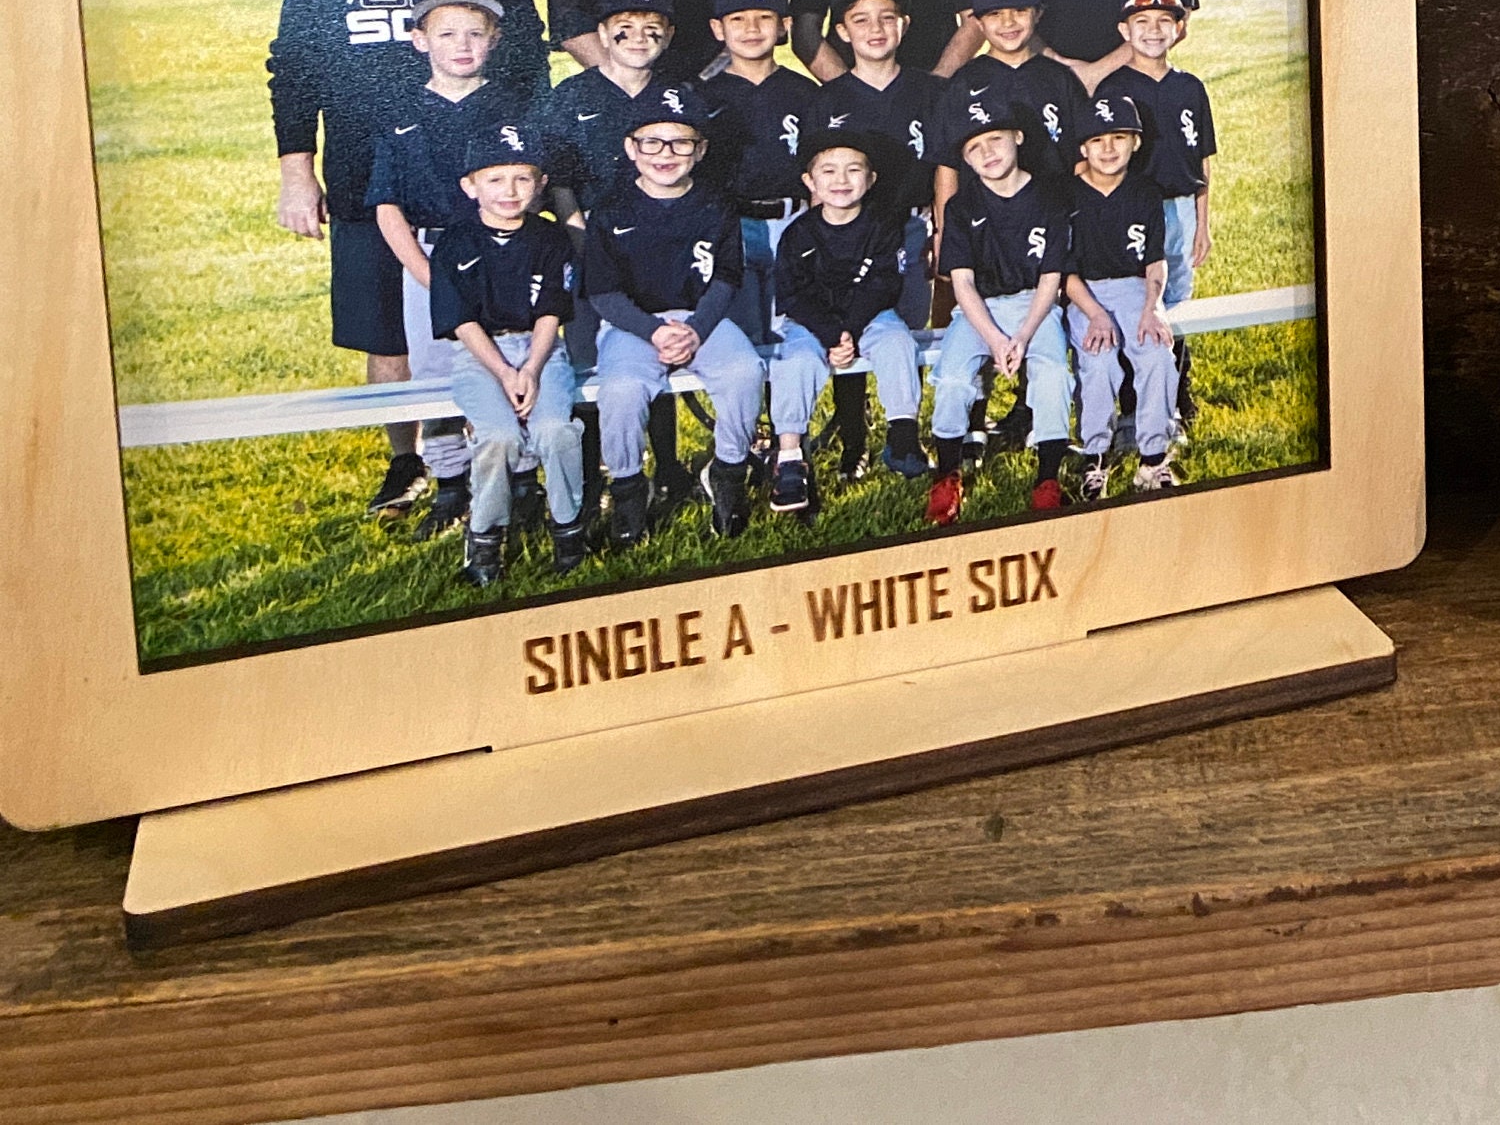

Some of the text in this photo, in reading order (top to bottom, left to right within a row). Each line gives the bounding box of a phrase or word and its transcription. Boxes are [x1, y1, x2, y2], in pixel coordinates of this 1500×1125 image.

[523, 547, 1060, 696] SINGLE A - WHITE SOX
